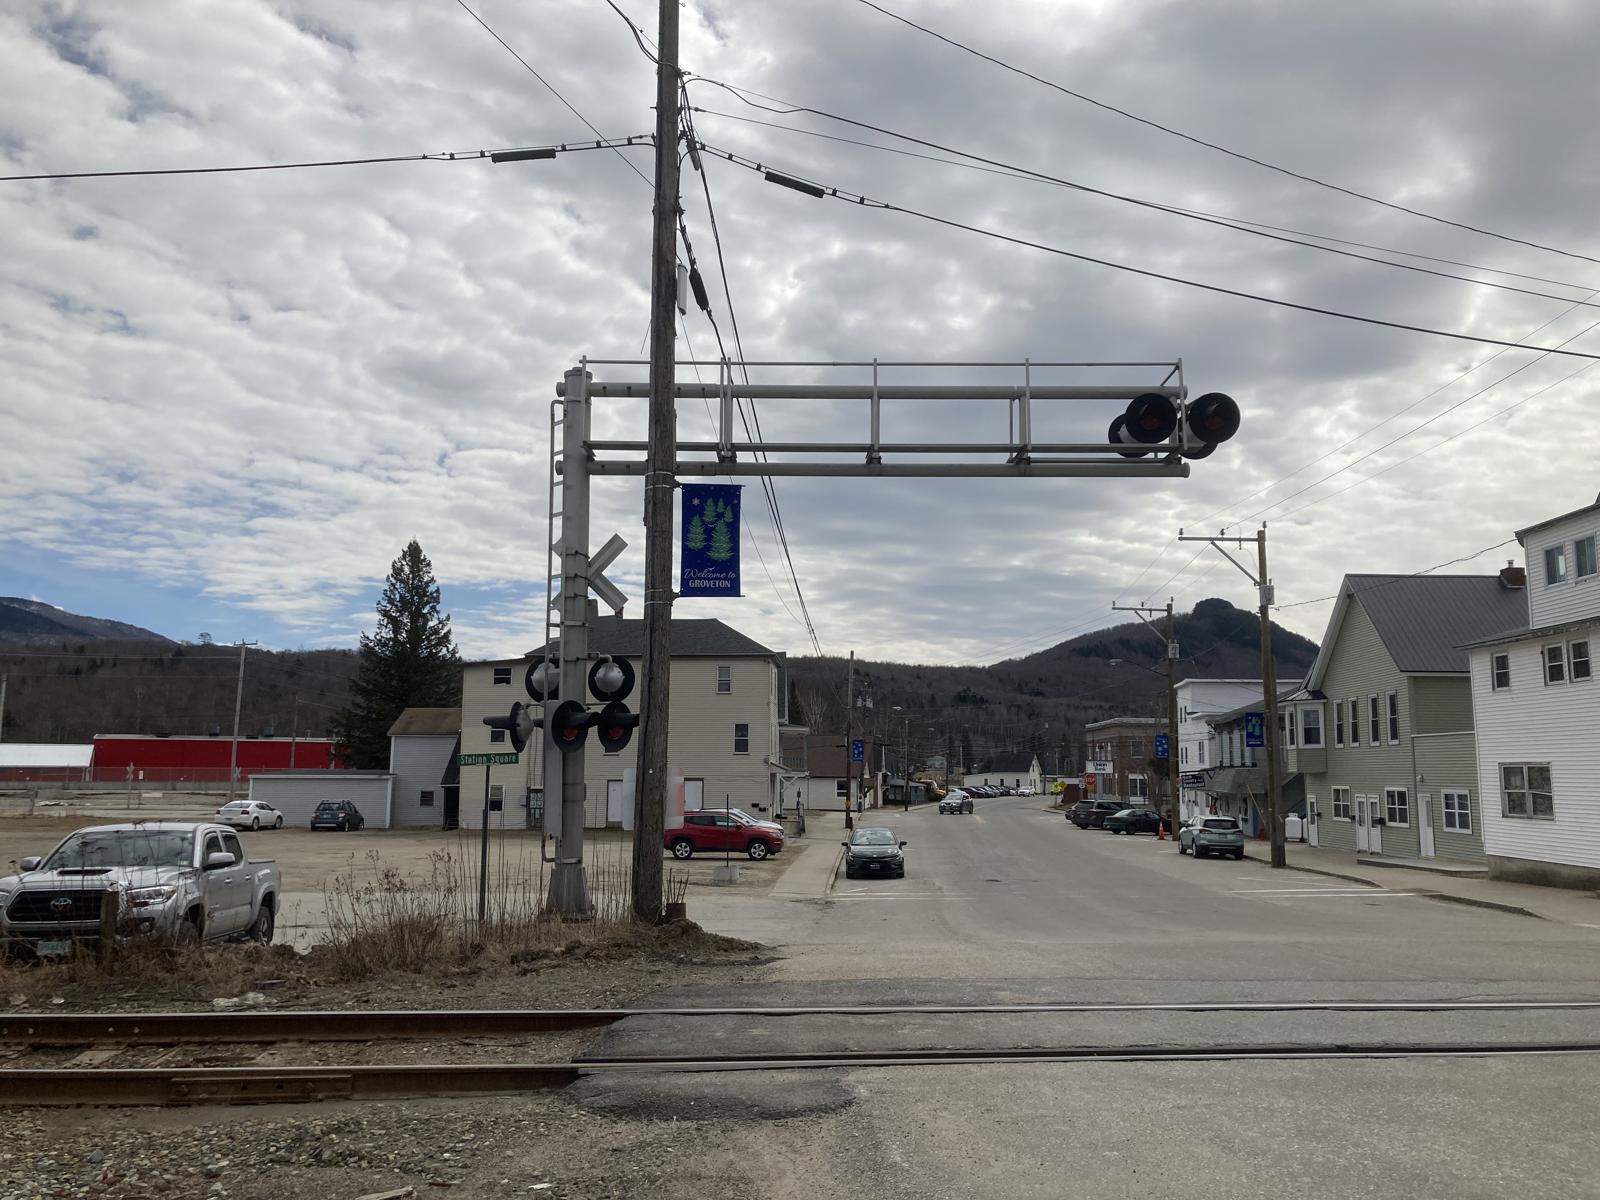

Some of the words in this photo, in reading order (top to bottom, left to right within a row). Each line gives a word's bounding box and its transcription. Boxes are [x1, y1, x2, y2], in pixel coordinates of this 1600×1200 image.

[684, 568, 726, 578] Welcome
[727, 569, 736, 578] to
[689, 579, 731, 588] GROVETON
[460, 755, 487, 765] Station
[490, 754, 516, 764] Square
